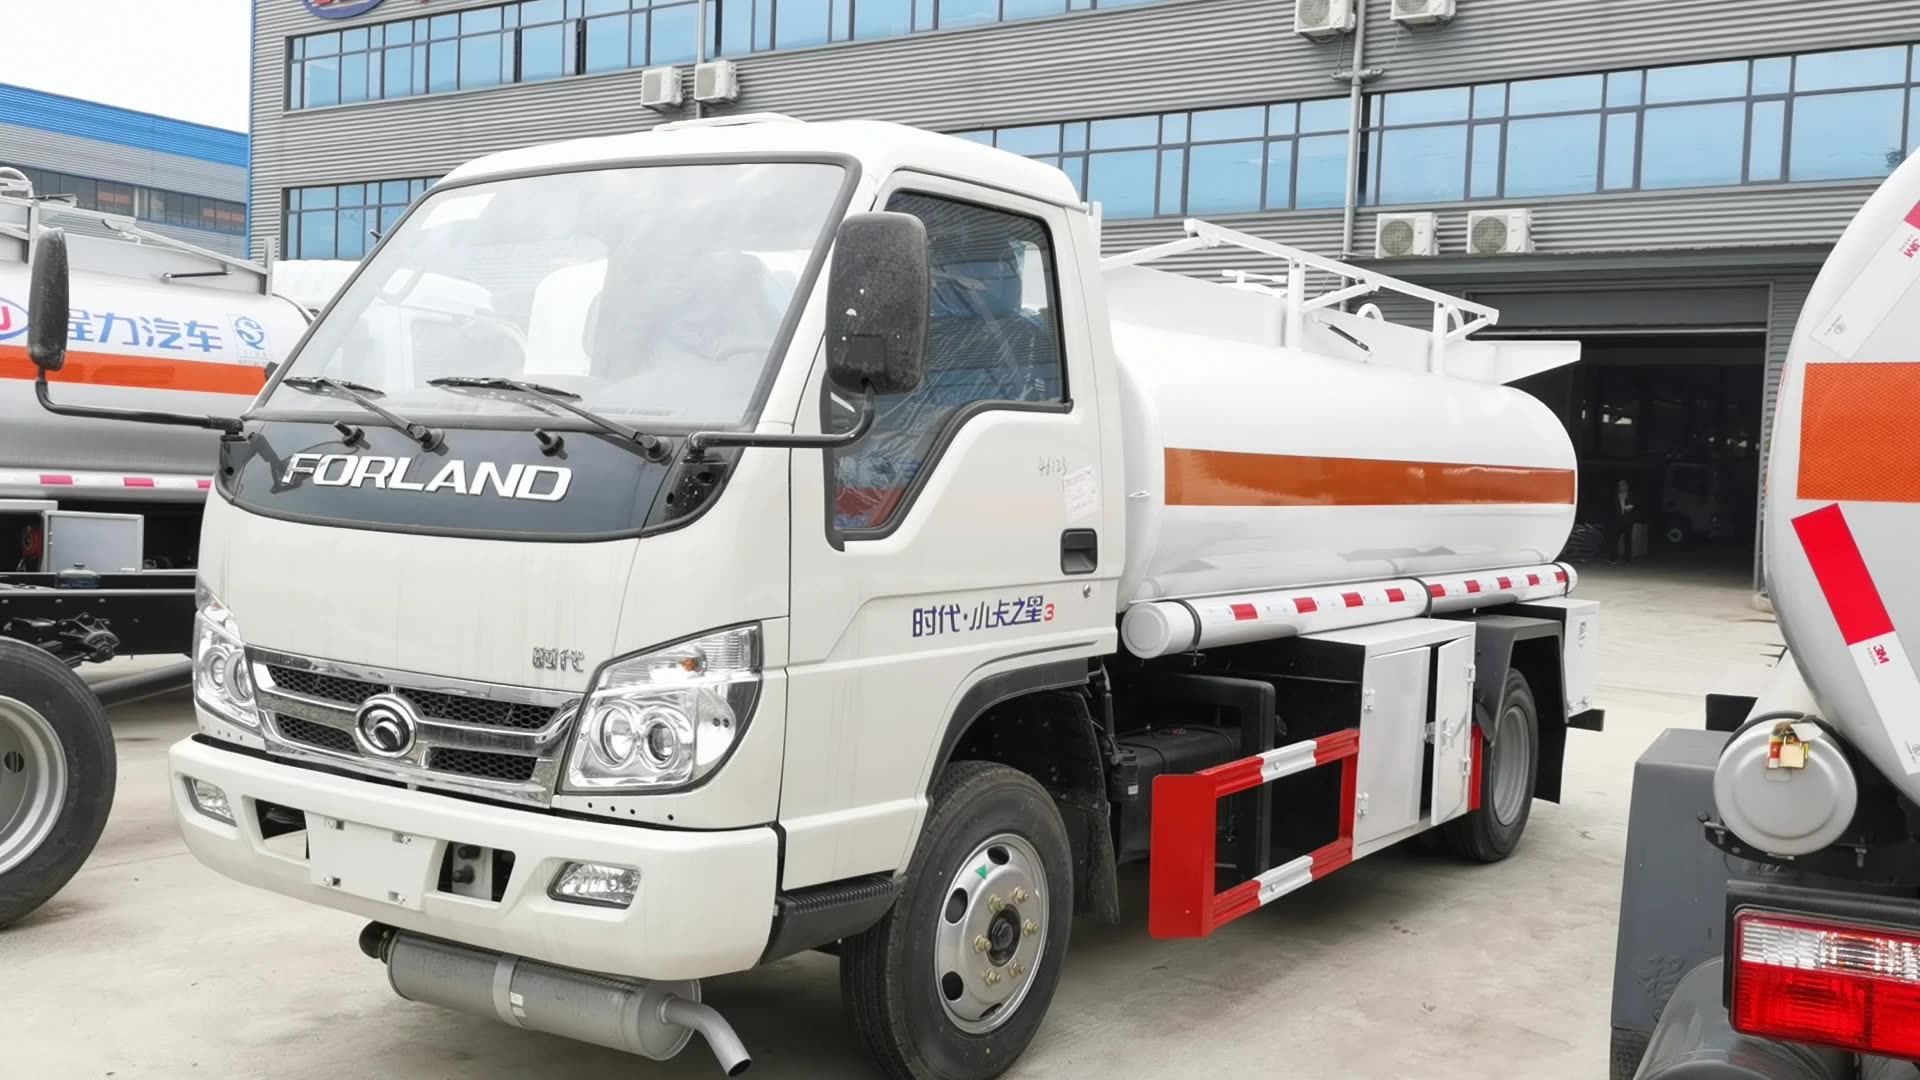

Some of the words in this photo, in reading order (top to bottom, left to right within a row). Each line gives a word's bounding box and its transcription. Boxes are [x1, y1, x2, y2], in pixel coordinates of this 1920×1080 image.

[281, 453, 571, 501] FORLAND
[533, 647, 585, 673] 时代
[1873, 644, 1890, 664] 3M
